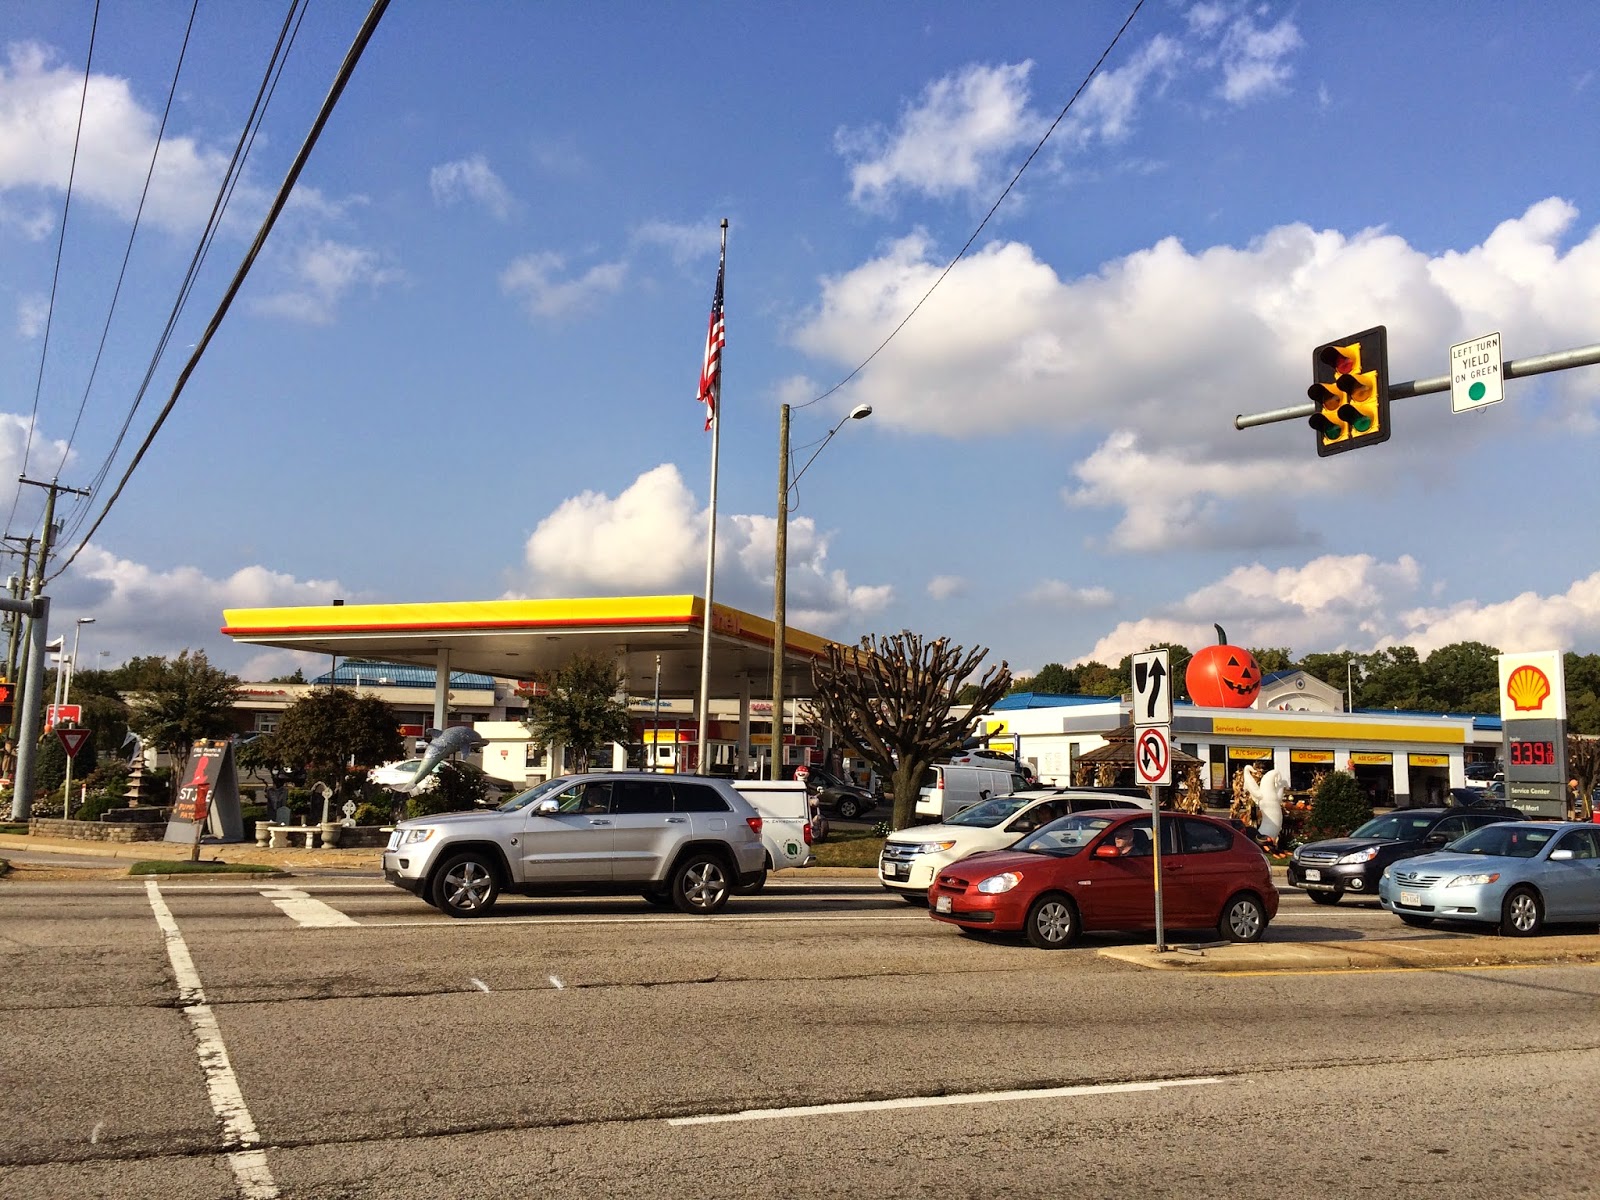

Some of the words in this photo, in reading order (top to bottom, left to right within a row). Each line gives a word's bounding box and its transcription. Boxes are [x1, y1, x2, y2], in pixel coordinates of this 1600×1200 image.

[1453, 346, 1472, 359] LEFT
[1476, 338, 1498, 352] TURN
[1462, 353, 1490, 370] YIELD
[1455, 373, 1466, 384] ON
[1470, 364, 1498, 379] GREEN
[179, 788, 193, 800] ST
